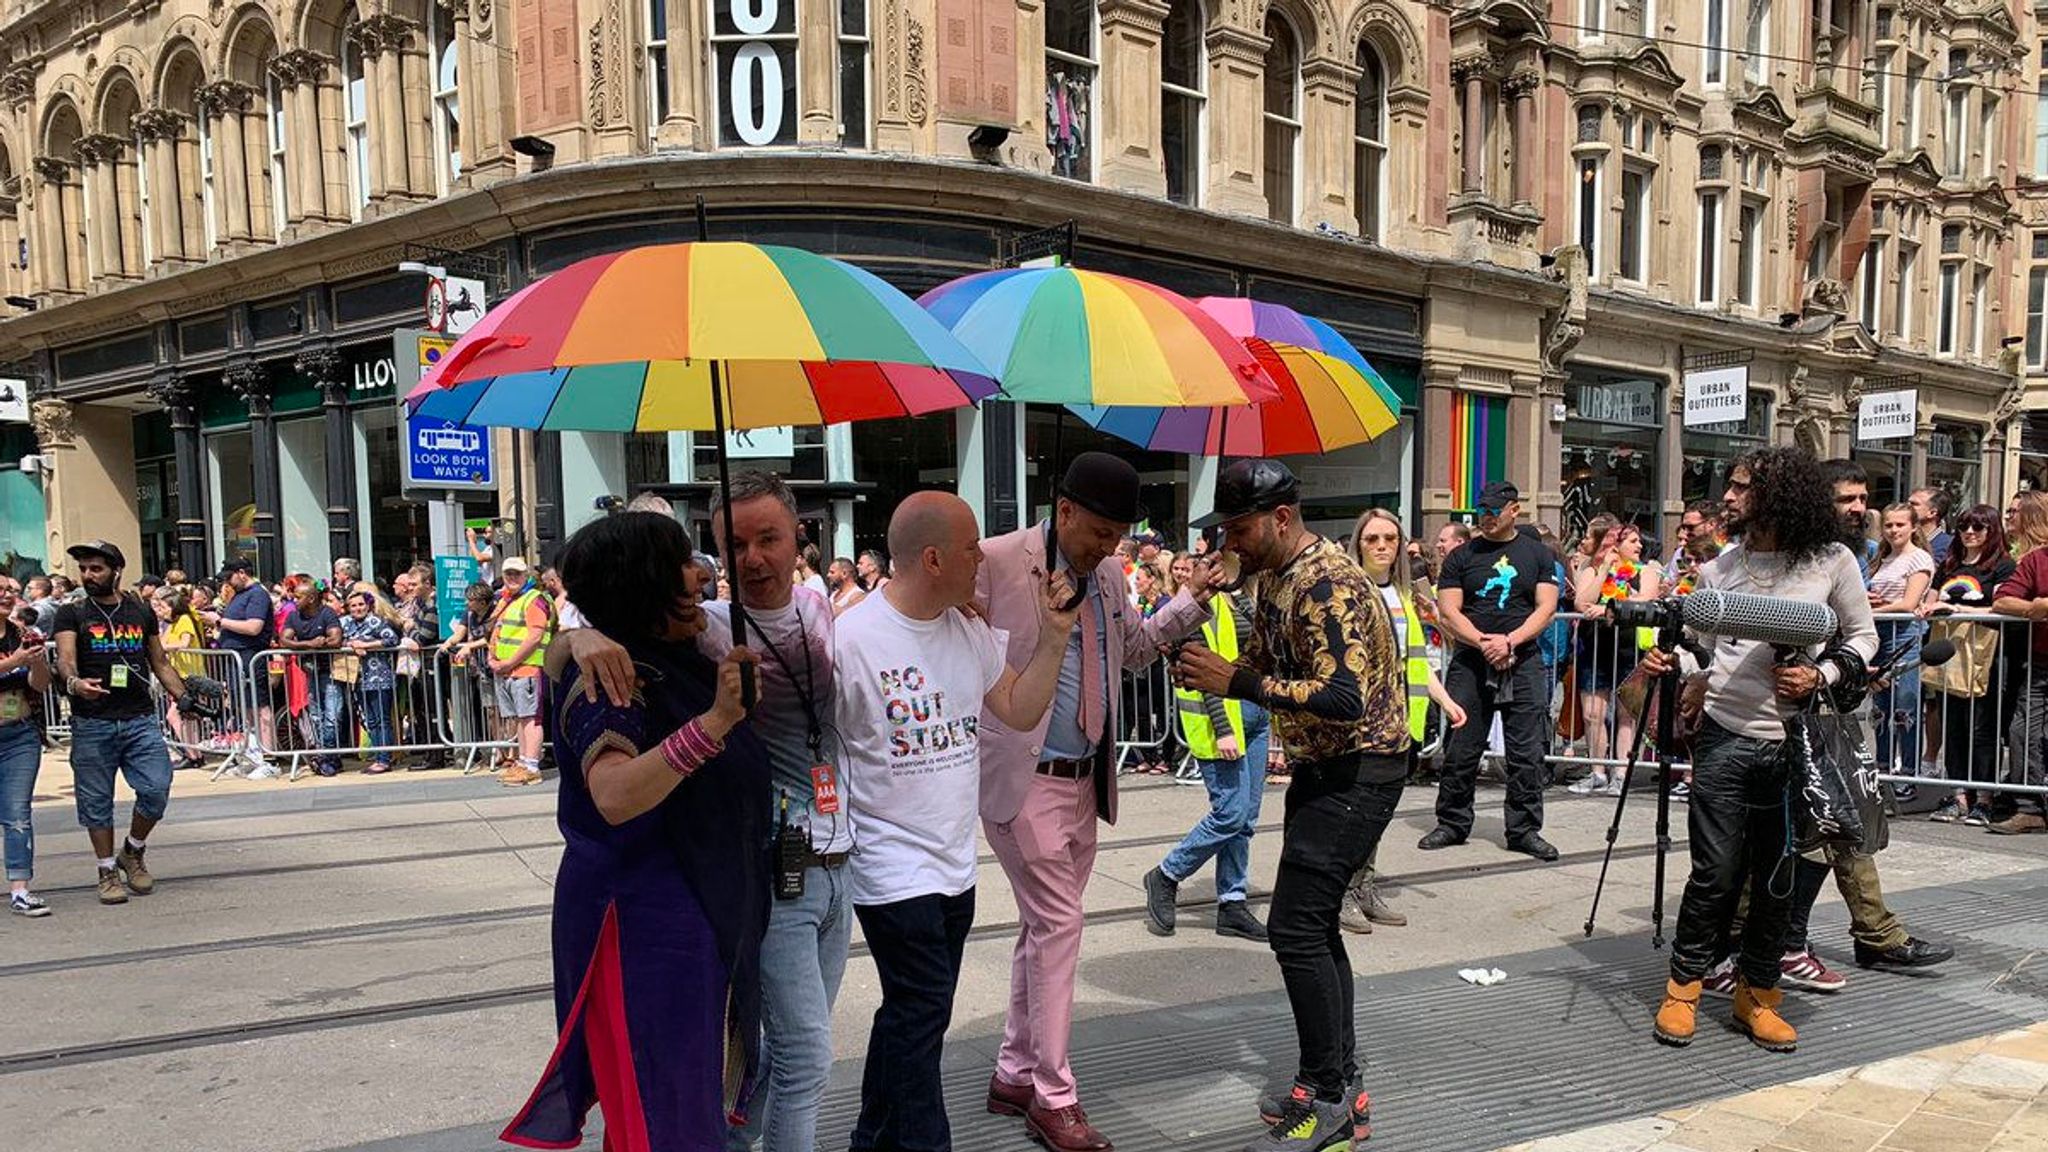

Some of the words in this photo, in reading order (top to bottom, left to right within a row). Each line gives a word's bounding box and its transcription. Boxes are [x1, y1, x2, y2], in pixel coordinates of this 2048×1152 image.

[1700, 382, 1731, 396] URBAN
[1687, 394, 1742, 411] OUTFITTERS
[1873, 402, 1902, 414] URBAN
[1862, 413, 1912, 427] OUTFITTERS
[414, 453, 449, 465] LOOK
[452, 455, 486, 466] BOTH
[433, 466, 469, 477] WAYS
[880, 665, 925, 695] NO
[886, 691, 944, 726] OUT
